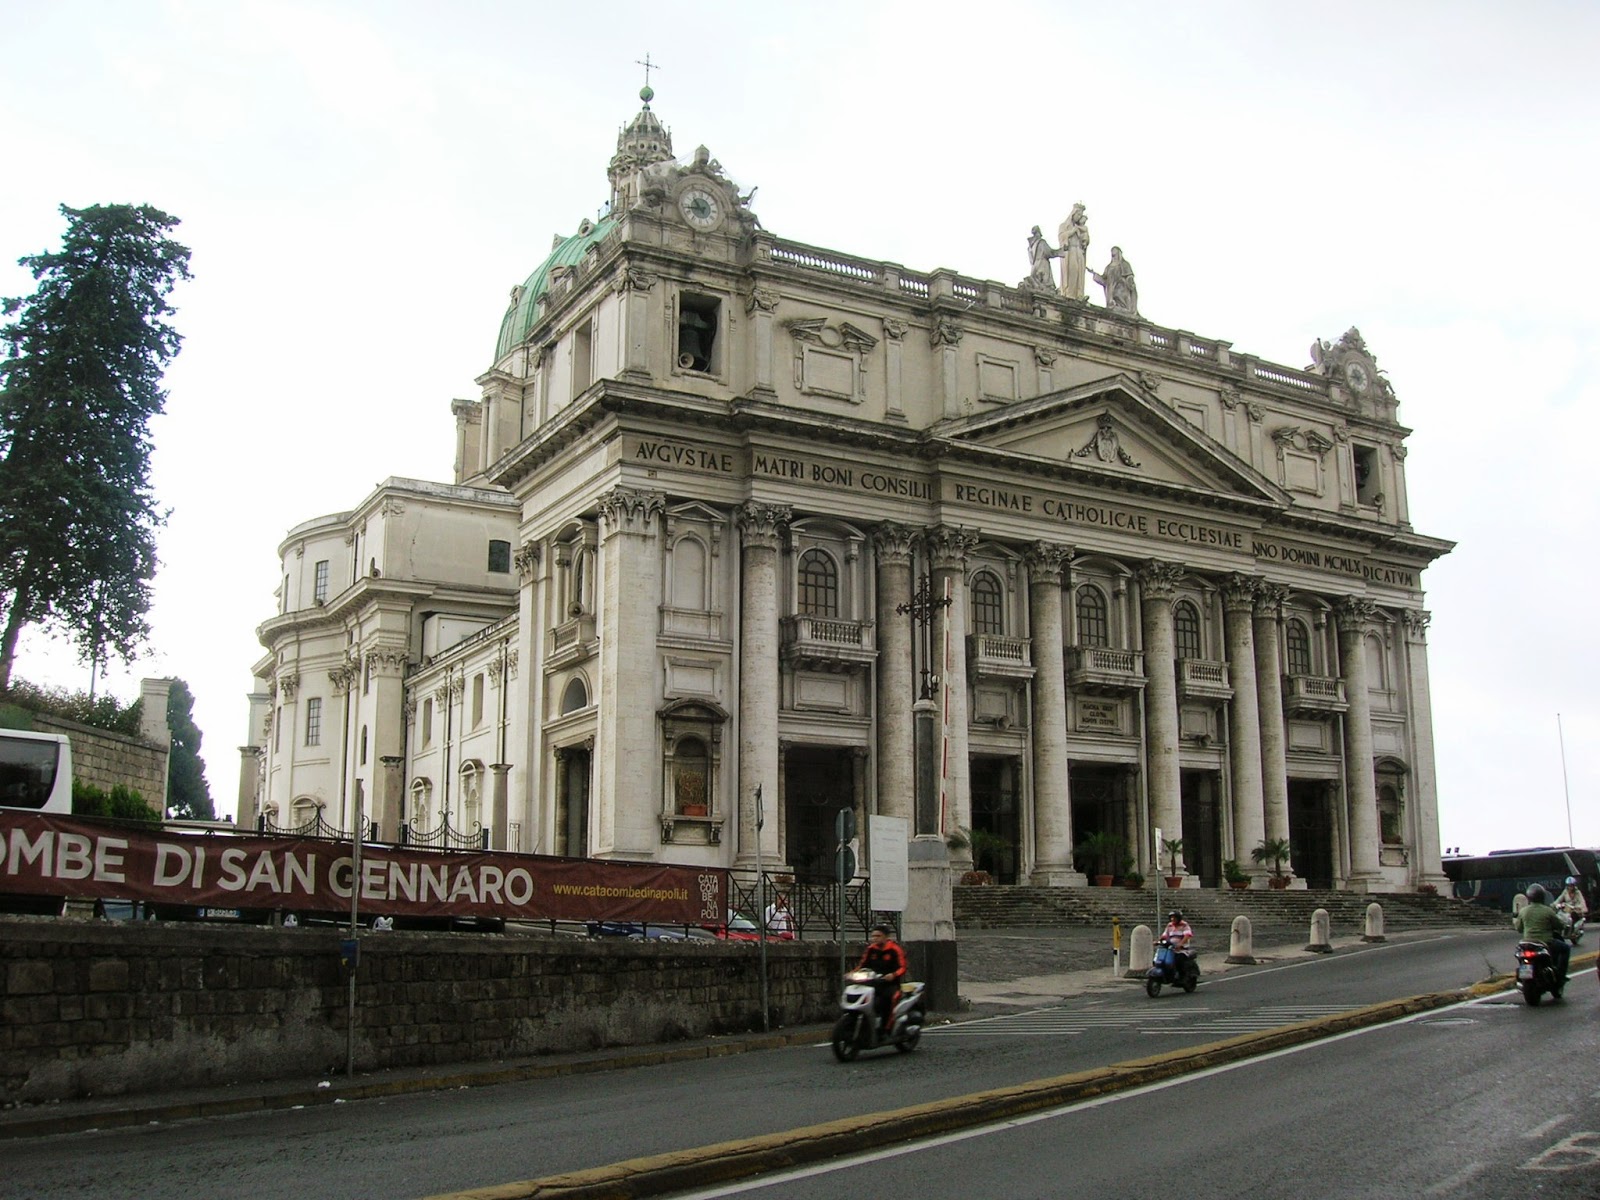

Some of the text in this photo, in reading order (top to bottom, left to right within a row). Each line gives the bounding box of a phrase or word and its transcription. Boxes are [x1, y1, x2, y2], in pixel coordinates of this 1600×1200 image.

[635, 442, 1414, 587] AVGVSTAE MATRI BONI CONSILII REGINAE CATHOLICAE ECCLESIAE NNO DOMINI MCMLX DICATVM
[0, 828, 534, 906] MBE DI SAN GENNARO
[698, 874, 719, 884] CATA
[552, 884, 689, 901] www.catacombedinapoli.it
[700, 883, 719, 893] COM
[702, 892, 713, 901] BE
[707, 901, 718, 910] NA
[701, 909, 719, 919] POLI
